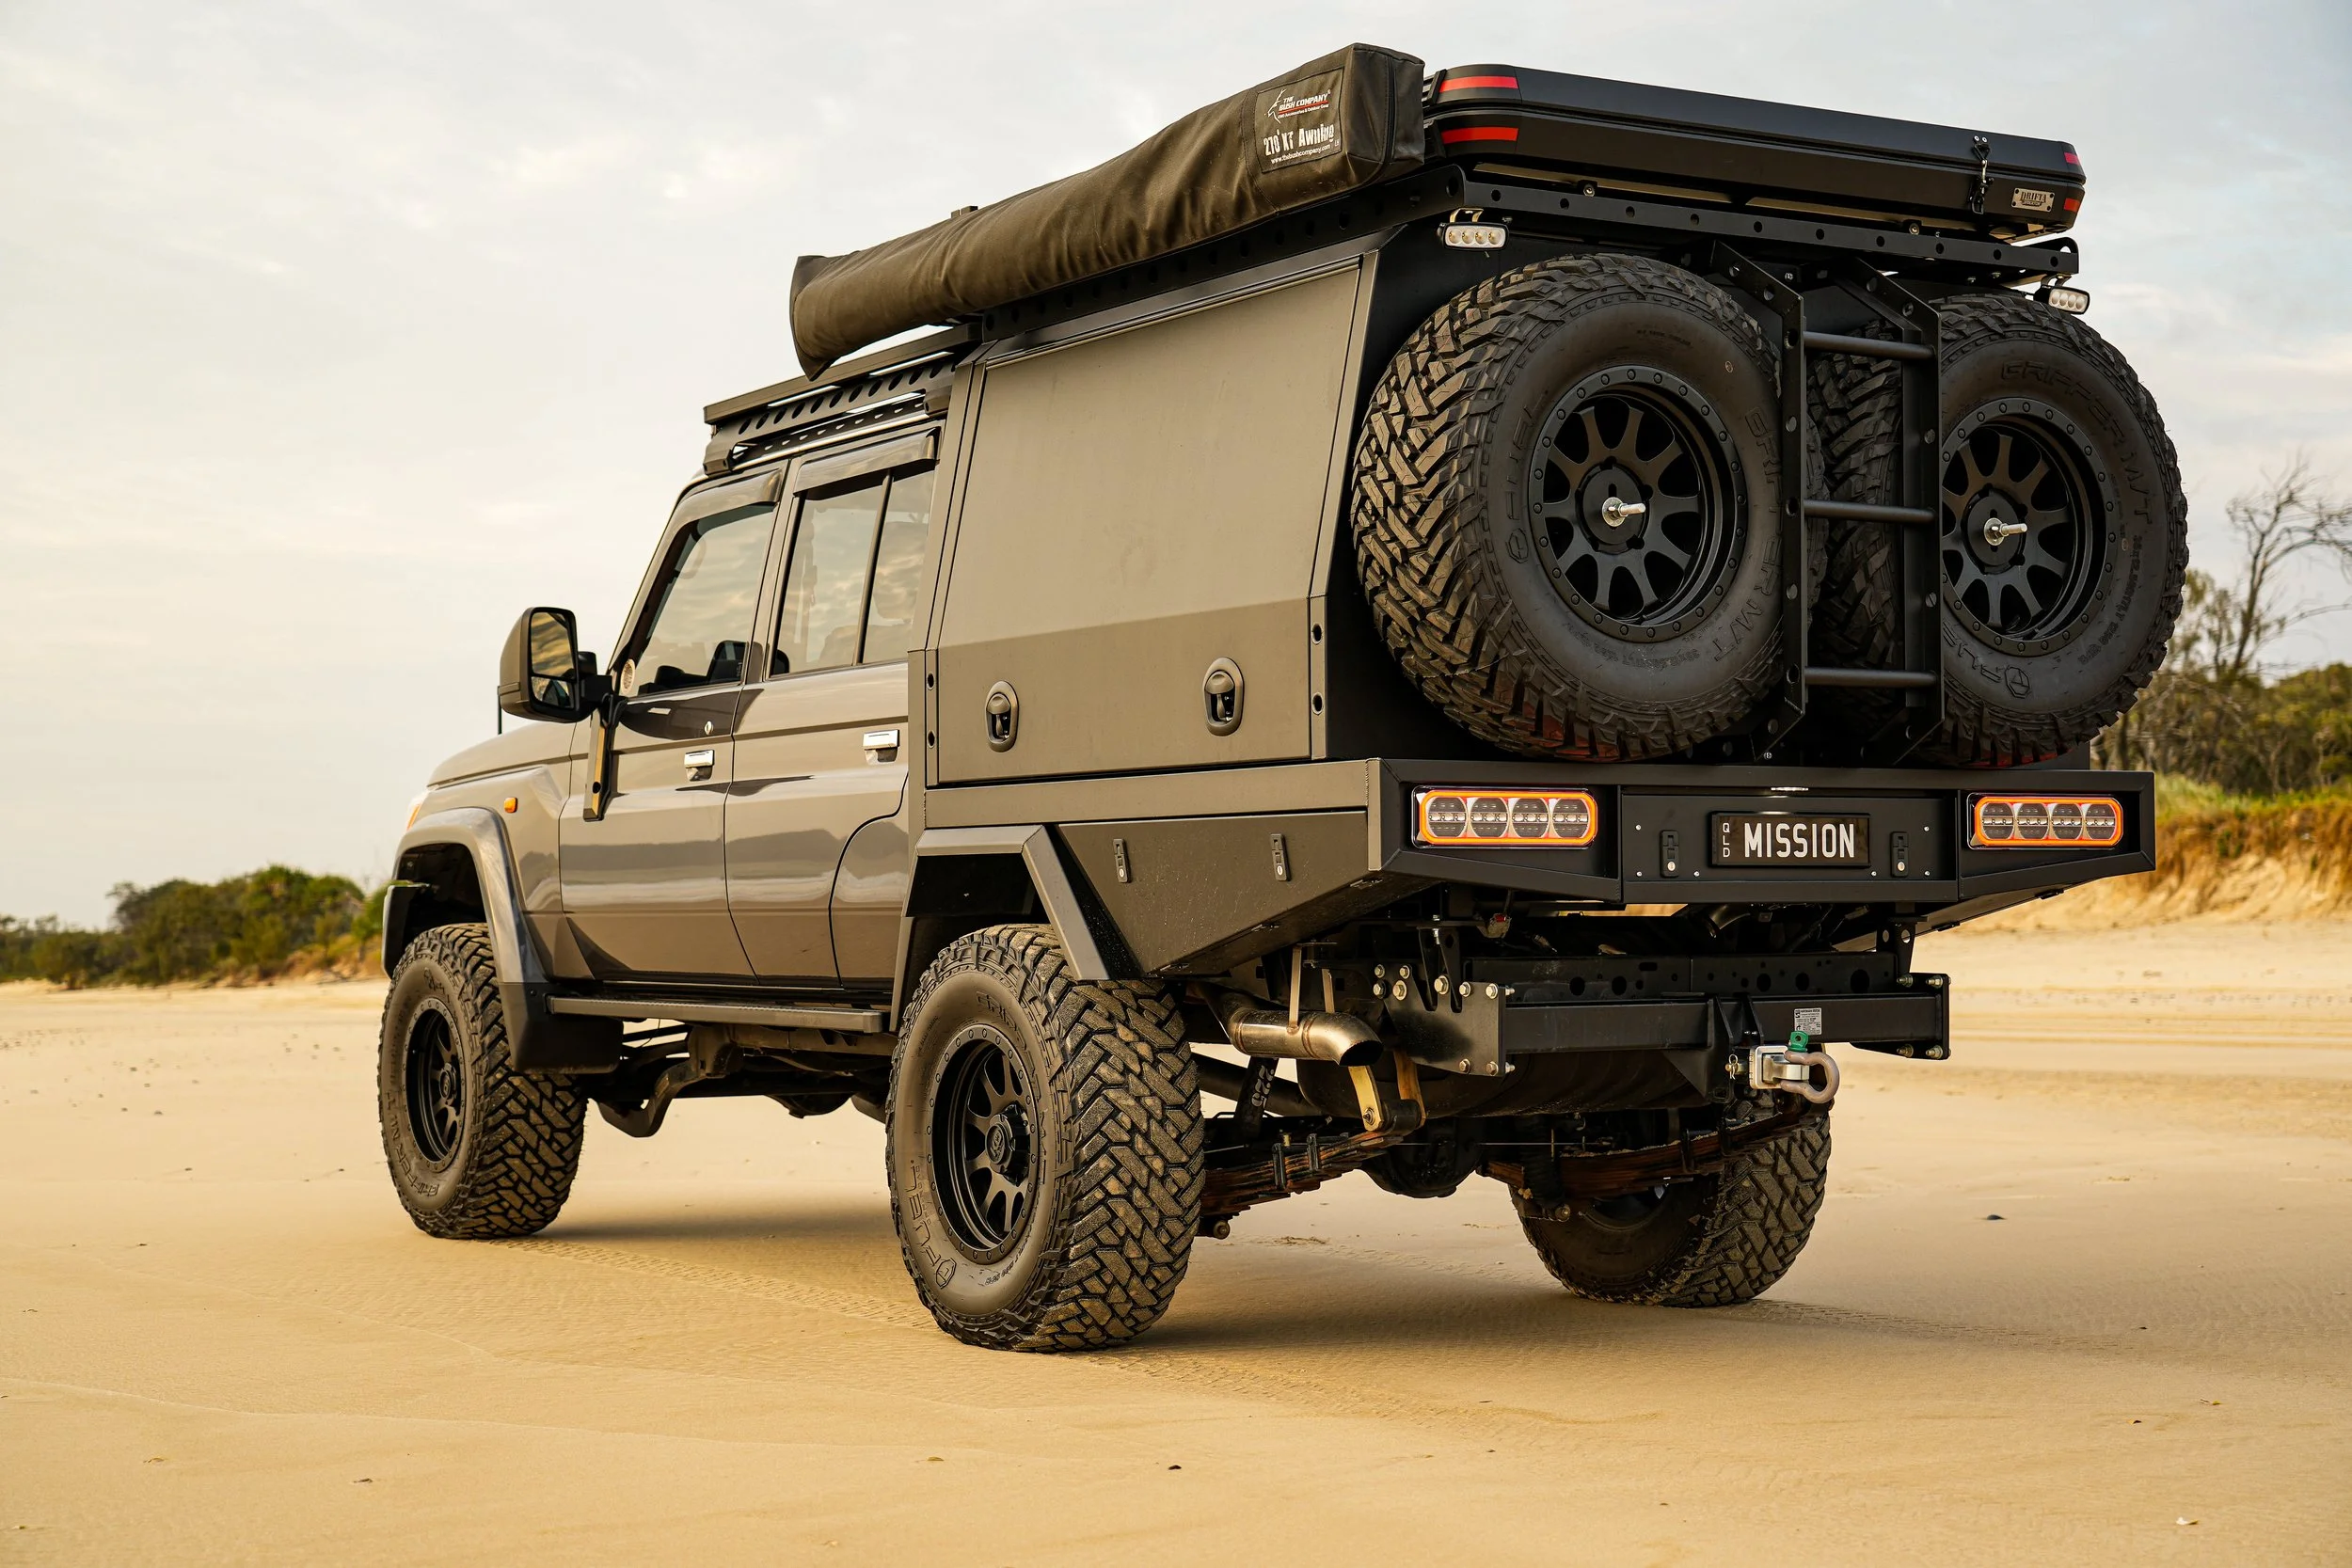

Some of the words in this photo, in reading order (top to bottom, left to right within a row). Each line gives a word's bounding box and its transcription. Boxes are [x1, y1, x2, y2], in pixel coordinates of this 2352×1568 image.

[1279, 101, 1295, 110] BUSH
[1295, 93, 1327, 105] COMPANY
[1298, 123, 1335, 148] Awning
[2020, 192, 2046, 203] DRIFTA
[1723, 822, 1731, 858] QLD
[1744, 822, 1854, 858] MISSION
[905, 1165, 942, 1267] FUEL
